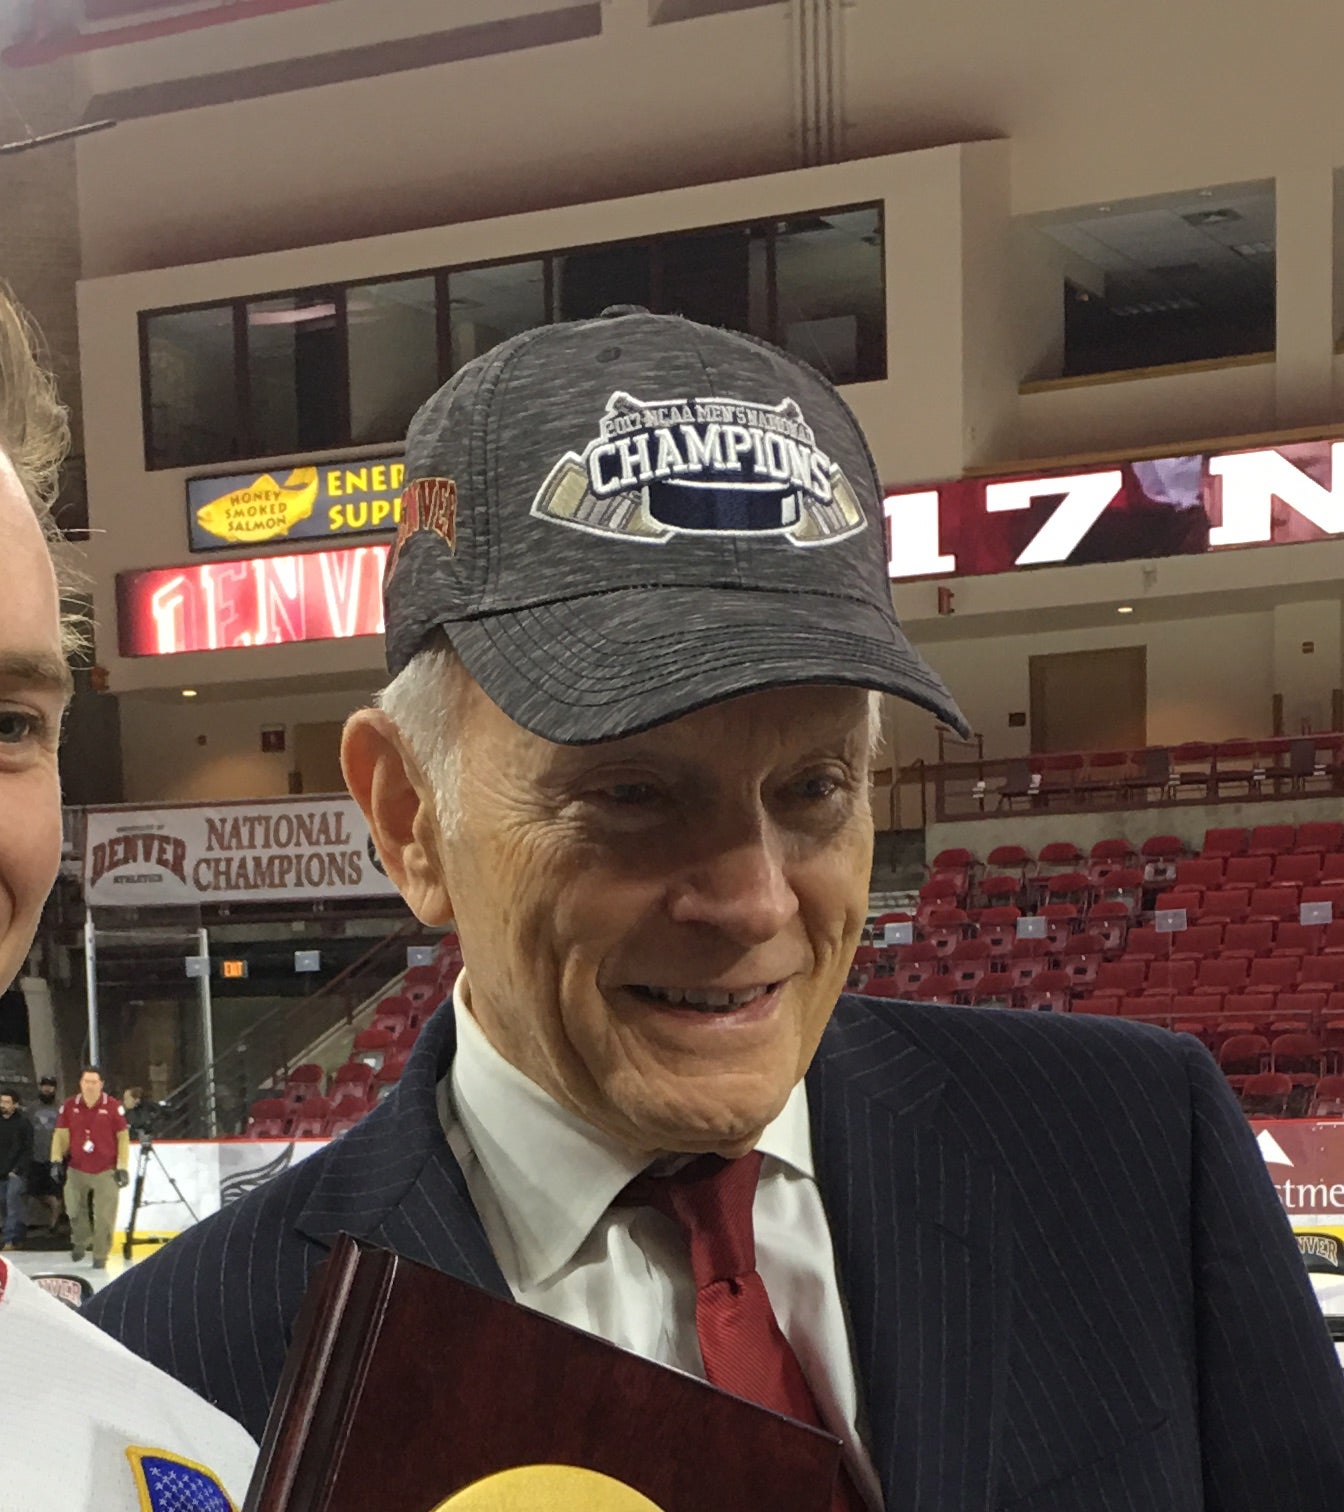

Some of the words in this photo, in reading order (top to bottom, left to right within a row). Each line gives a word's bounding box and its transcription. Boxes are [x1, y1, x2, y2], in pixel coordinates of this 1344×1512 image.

[588, 423, 833, 497] CHAMPIONS
[225, 503, 287, 519] SMOKED
[230, 490, 281, 507] HONEY
[228, 516, 287, 532] SALMON
[205, 810, 352, 852] NATIONAL
[91, 832, 187, 889] DENVER
[192, 850, 363, 893] CHAMPIONS
[1296, 1234, 1339, 1267] NVER
